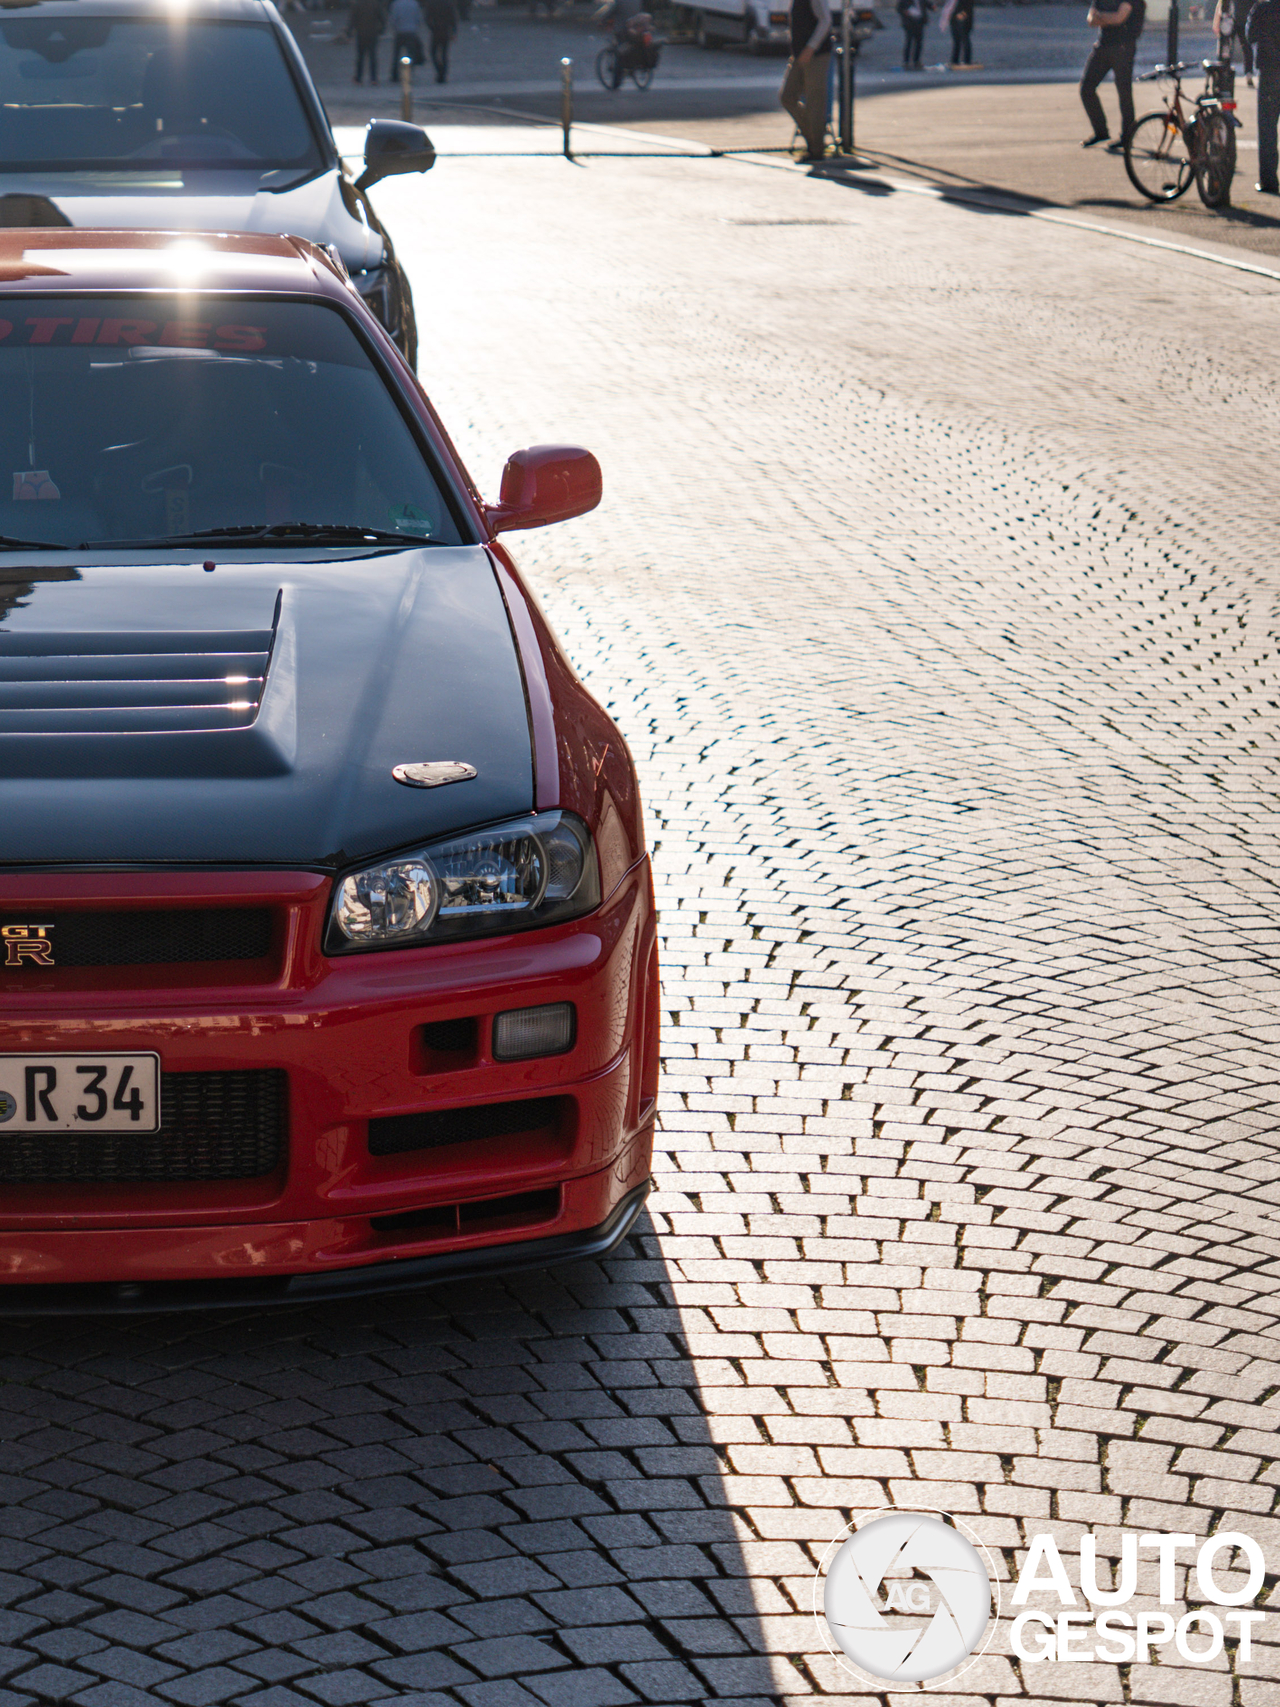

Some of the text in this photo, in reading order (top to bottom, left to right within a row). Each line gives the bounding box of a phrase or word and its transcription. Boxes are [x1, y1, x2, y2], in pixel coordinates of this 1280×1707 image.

[24, 316, 268, 351] TIRES
[1, 924, 55, 938] GT
[4, 939, 55, 966] R
